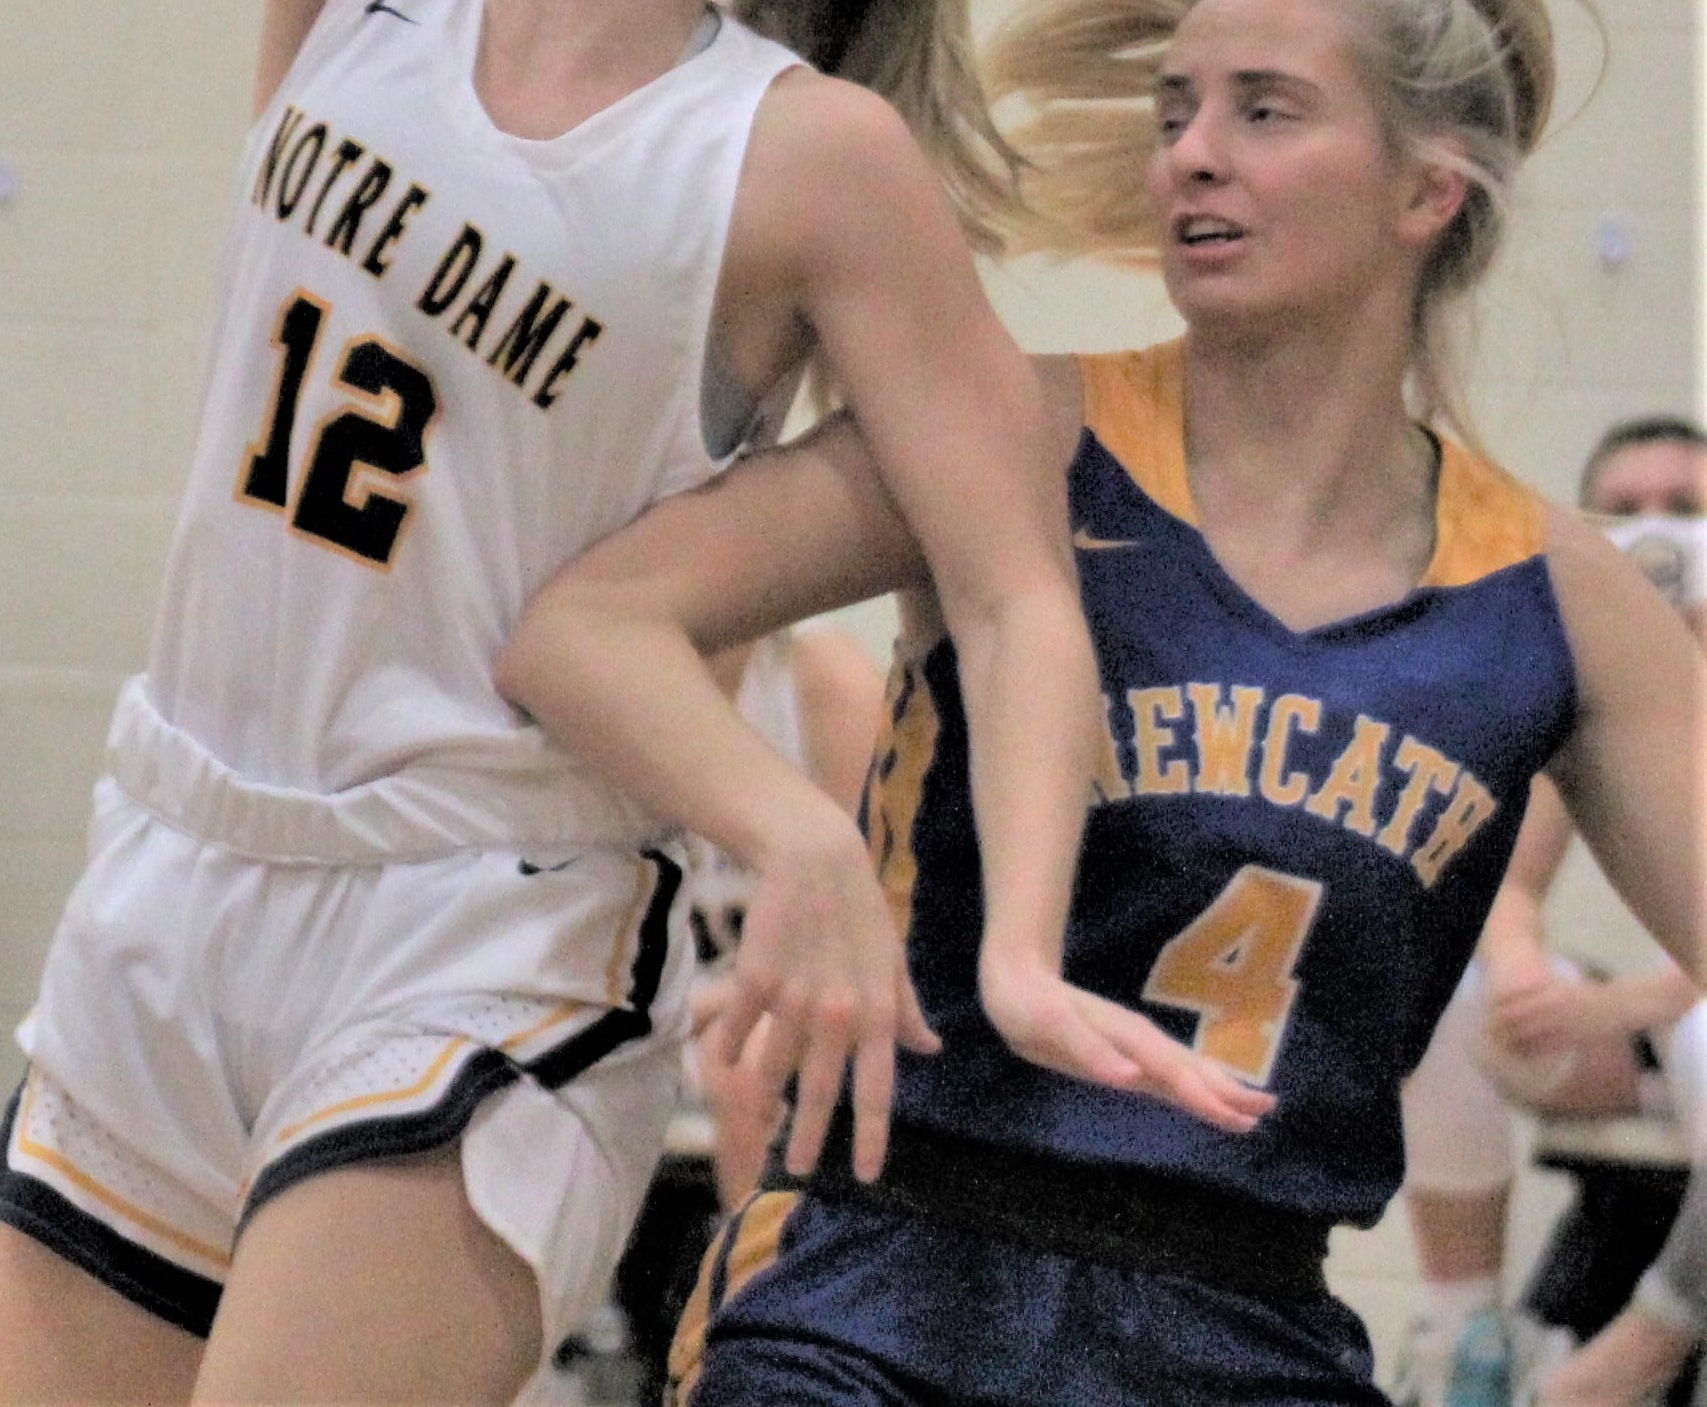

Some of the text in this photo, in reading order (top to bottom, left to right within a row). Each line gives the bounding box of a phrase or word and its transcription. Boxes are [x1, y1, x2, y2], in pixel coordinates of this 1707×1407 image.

[251, 105, 607, 411] NOTRE DAME
[232, 286, 443, 572] 12
[1140, 862, 1325, 1089] 4
